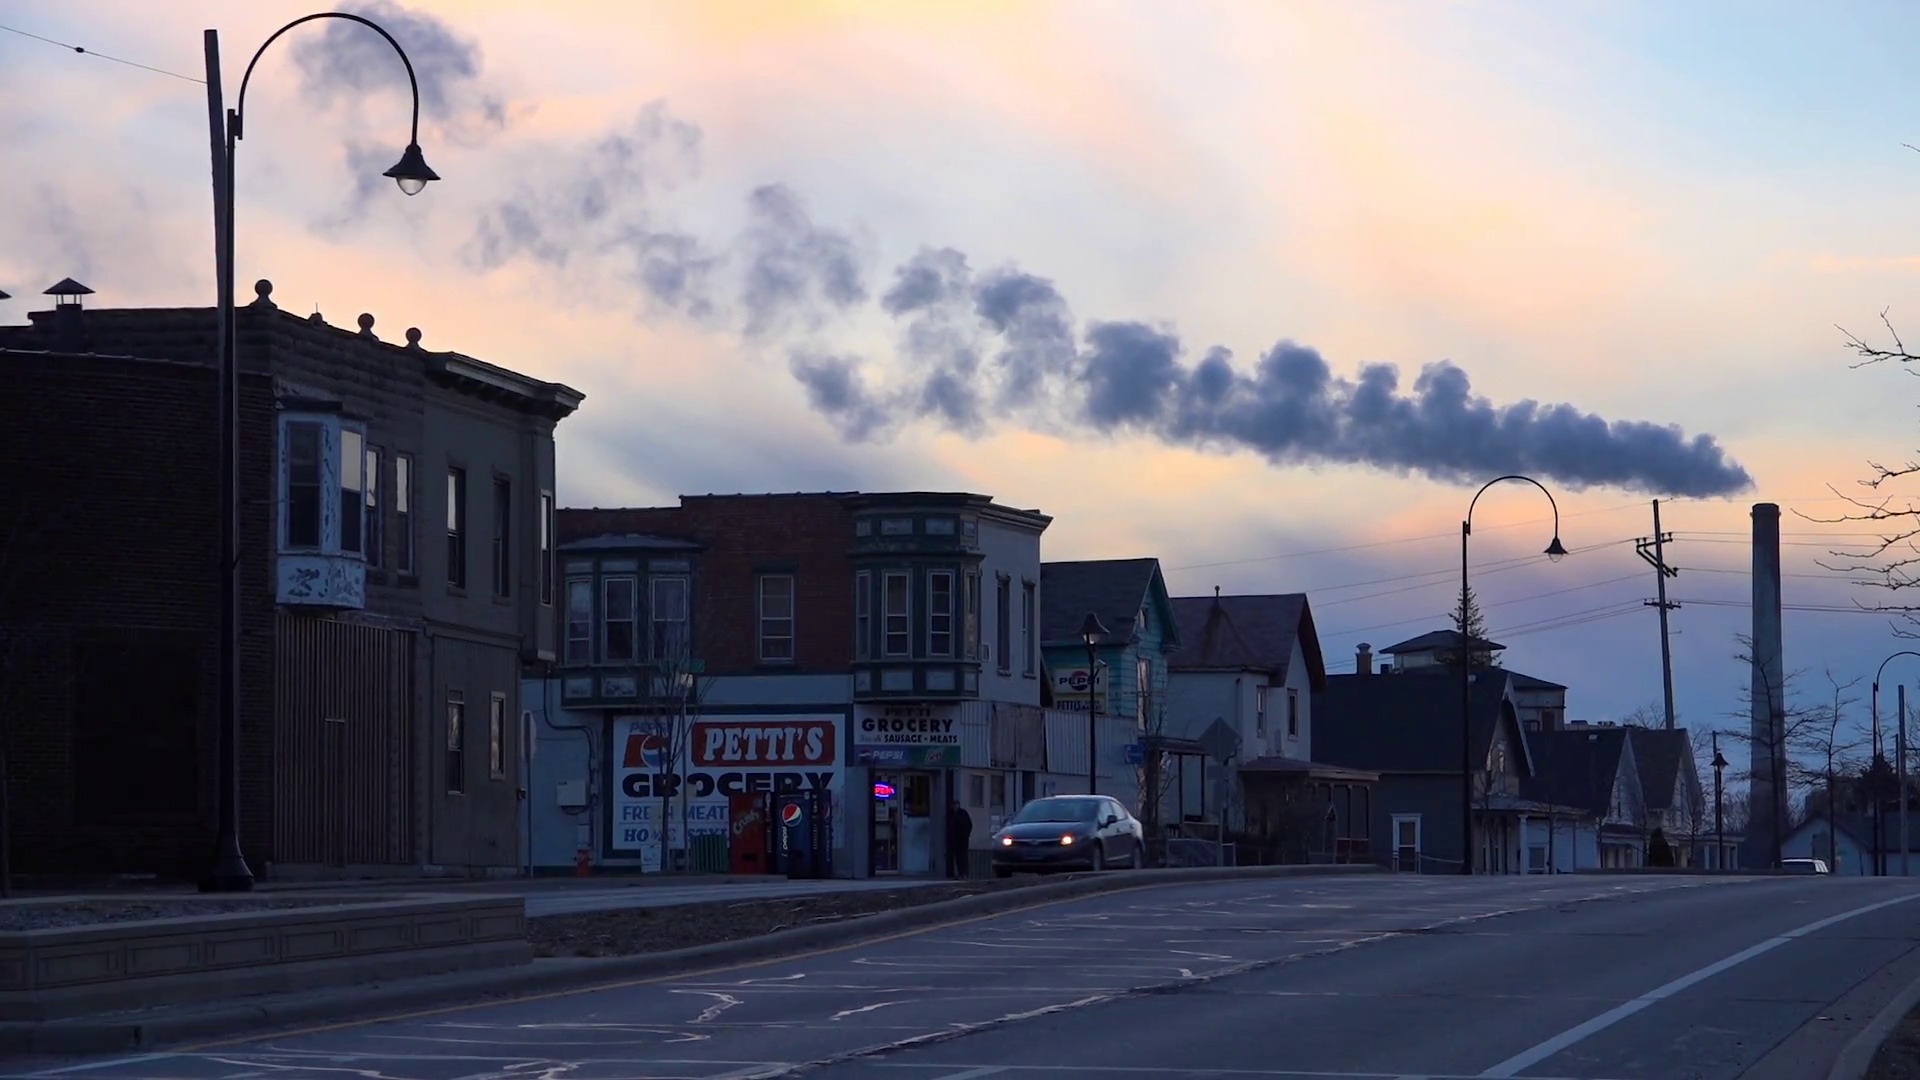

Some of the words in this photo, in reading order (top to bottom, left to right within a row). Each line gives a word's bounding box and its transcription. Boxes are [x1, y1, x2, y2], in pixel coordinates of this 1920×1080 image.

[861, 718, 953, 733] GROCERY
[703, 727, 825, 762] PETTI'S
[884, 734, 922, 743] SAUSAGE
[929, 735, 958, 743] MEATS
[872, 750, 904, 760] PEPSI
[622, 772, 834, 798] GROCERY
[623, 806, 674, 821] FREH
[733, 810, 761, 835] Crush
